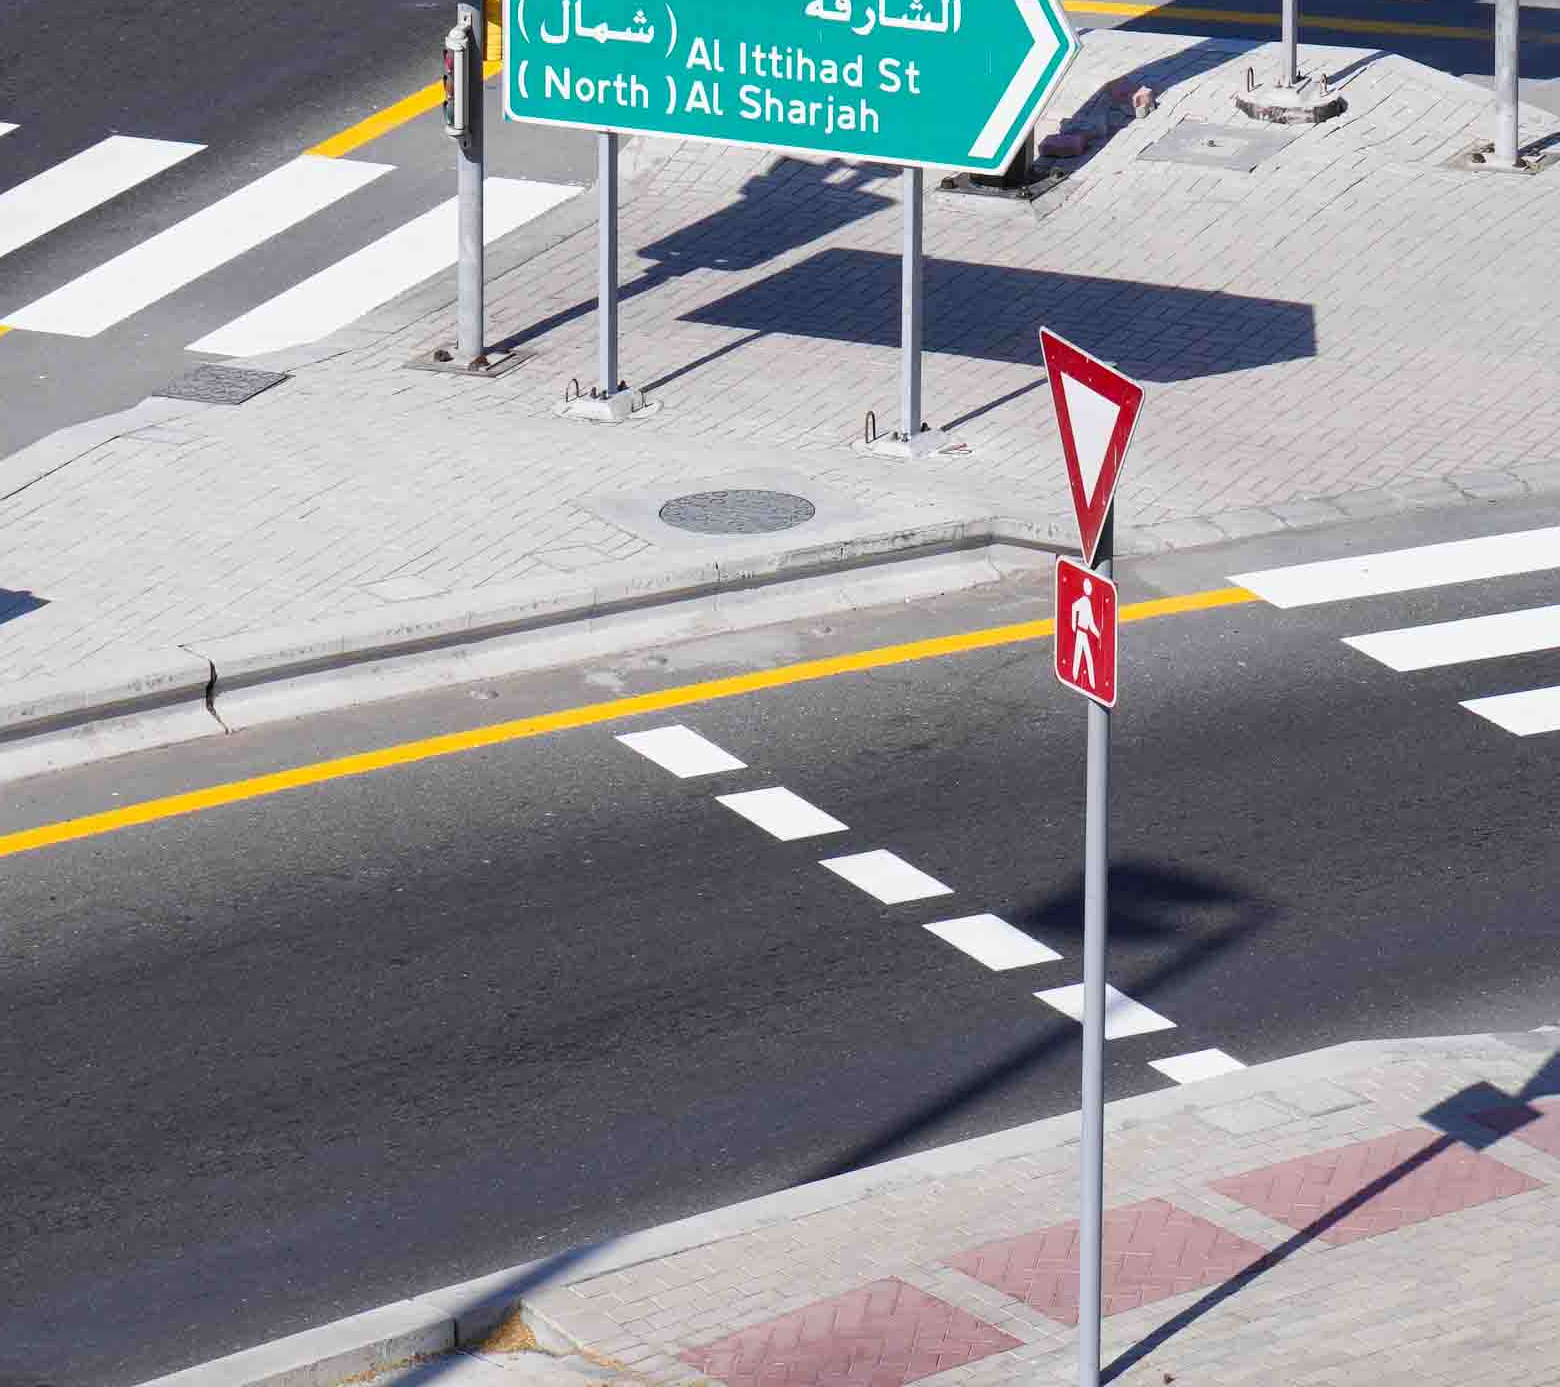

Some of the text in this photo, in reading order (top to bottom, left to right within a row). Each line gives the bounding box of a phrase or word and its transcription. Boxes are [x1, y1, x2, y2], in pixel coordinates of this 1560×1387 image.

[686, 37, 921, 94] Al Ittihad St
[685, 80, 879, 134] Al Sharjah
